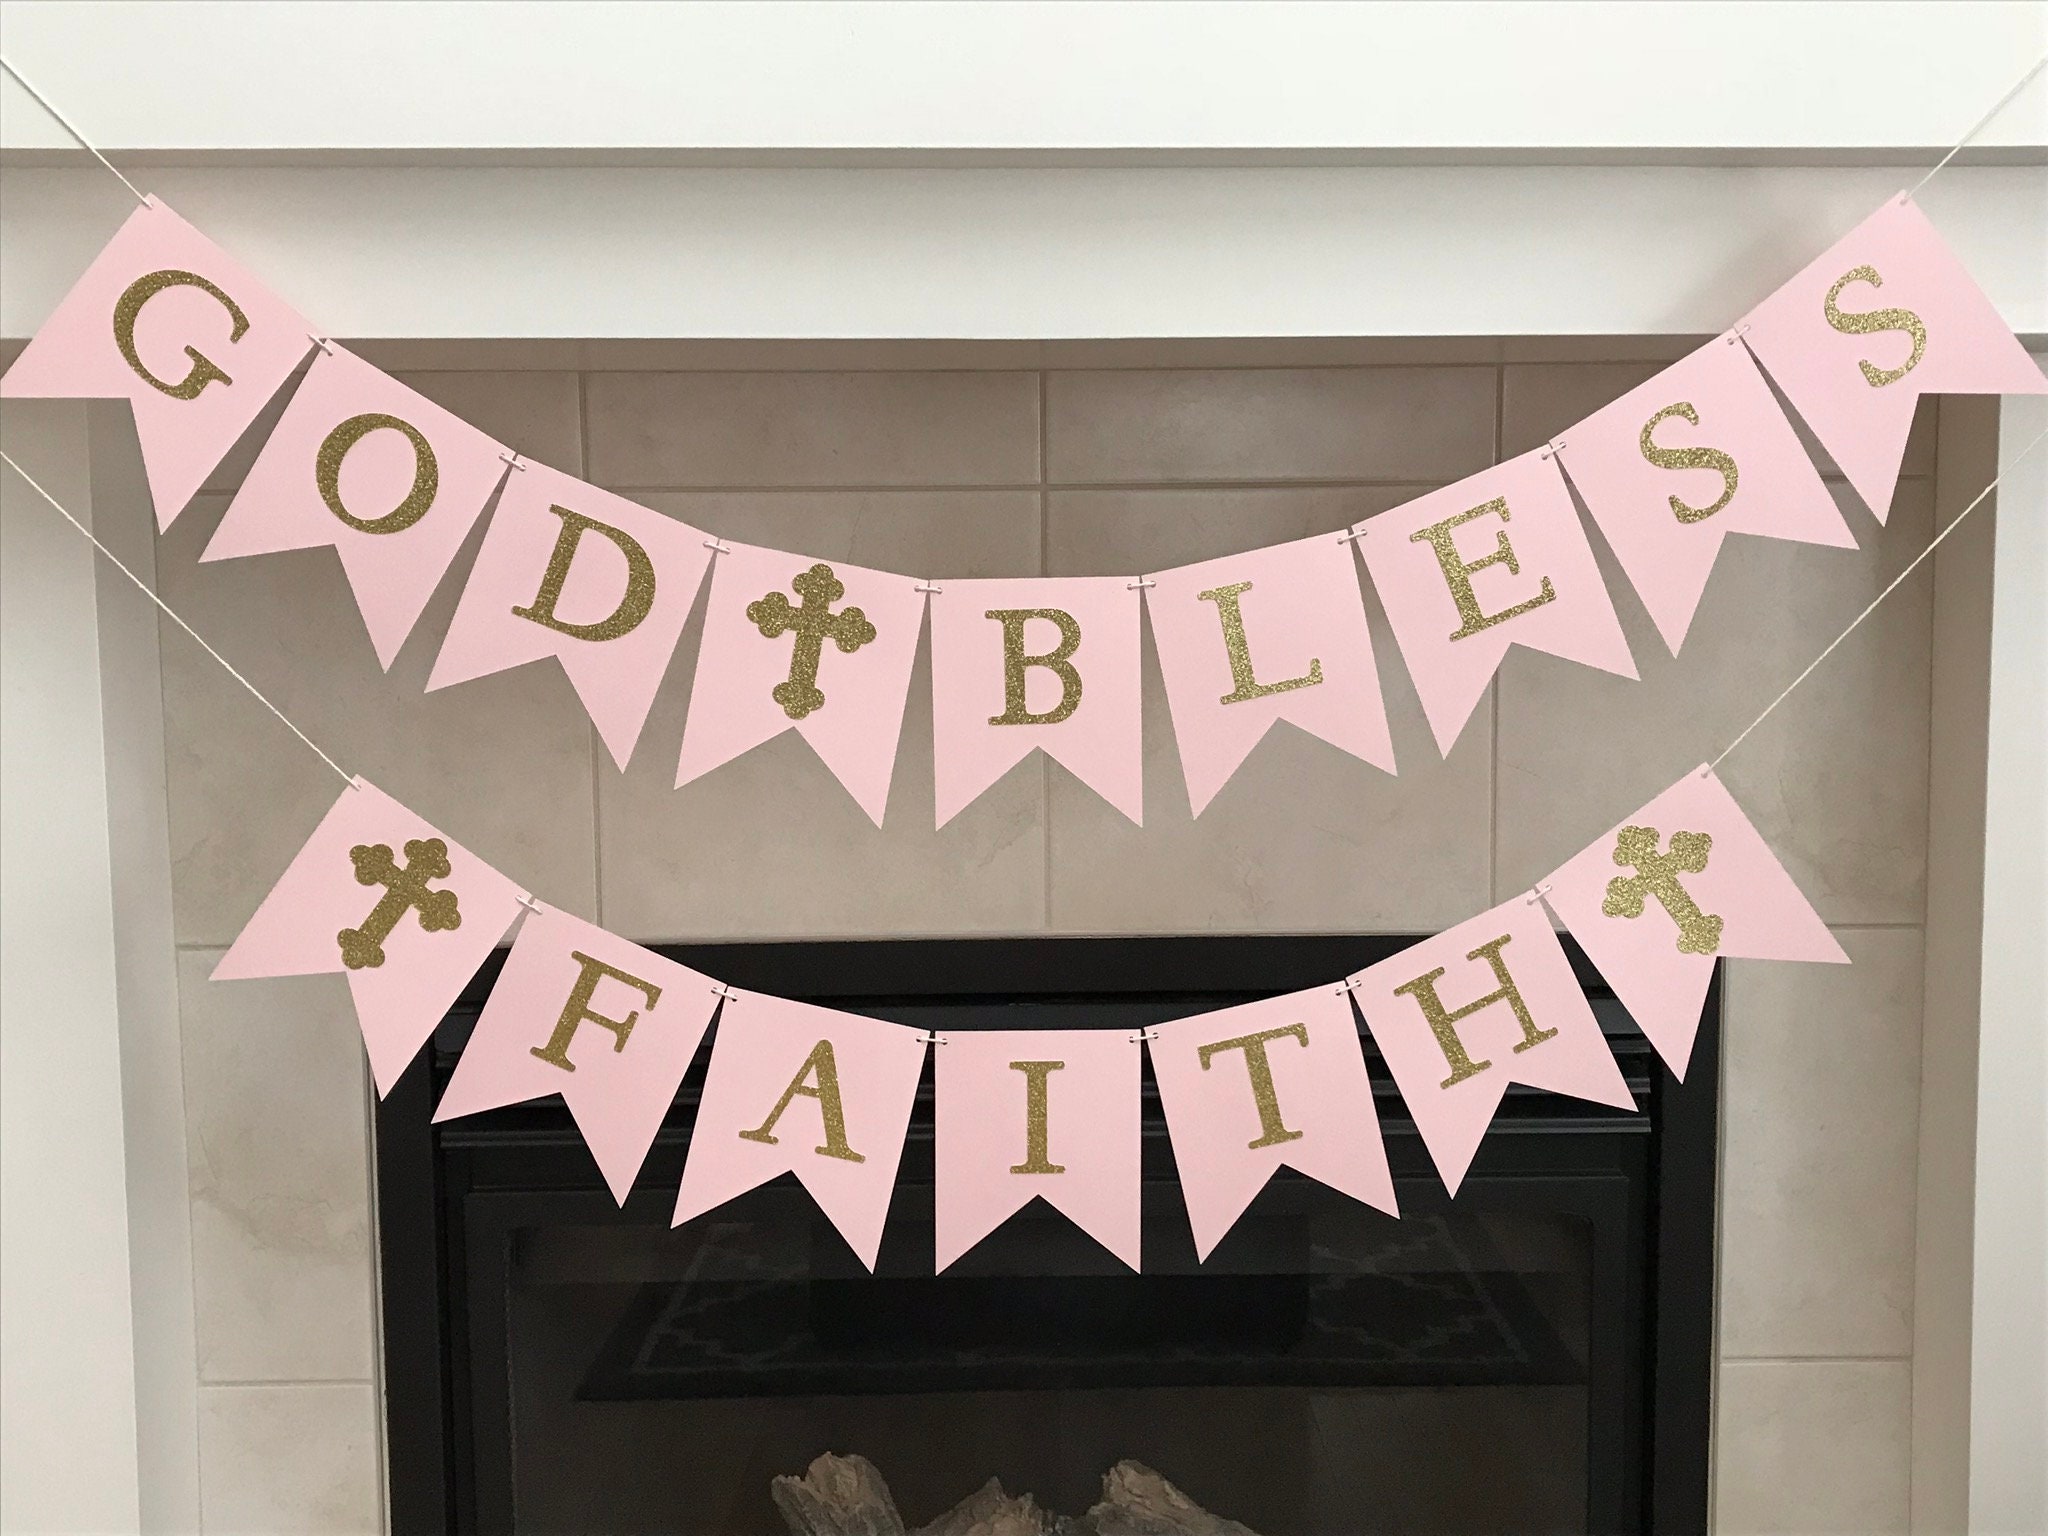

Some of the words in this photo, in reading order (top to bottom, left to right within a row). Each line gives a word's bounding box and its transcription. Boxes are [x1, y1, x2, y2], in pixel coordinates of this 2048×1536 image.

[112, 269, 656, 642] GOD
[986, 264, 1927, 726] BLESS
[530, 933, 1558, 1175] FAITH
